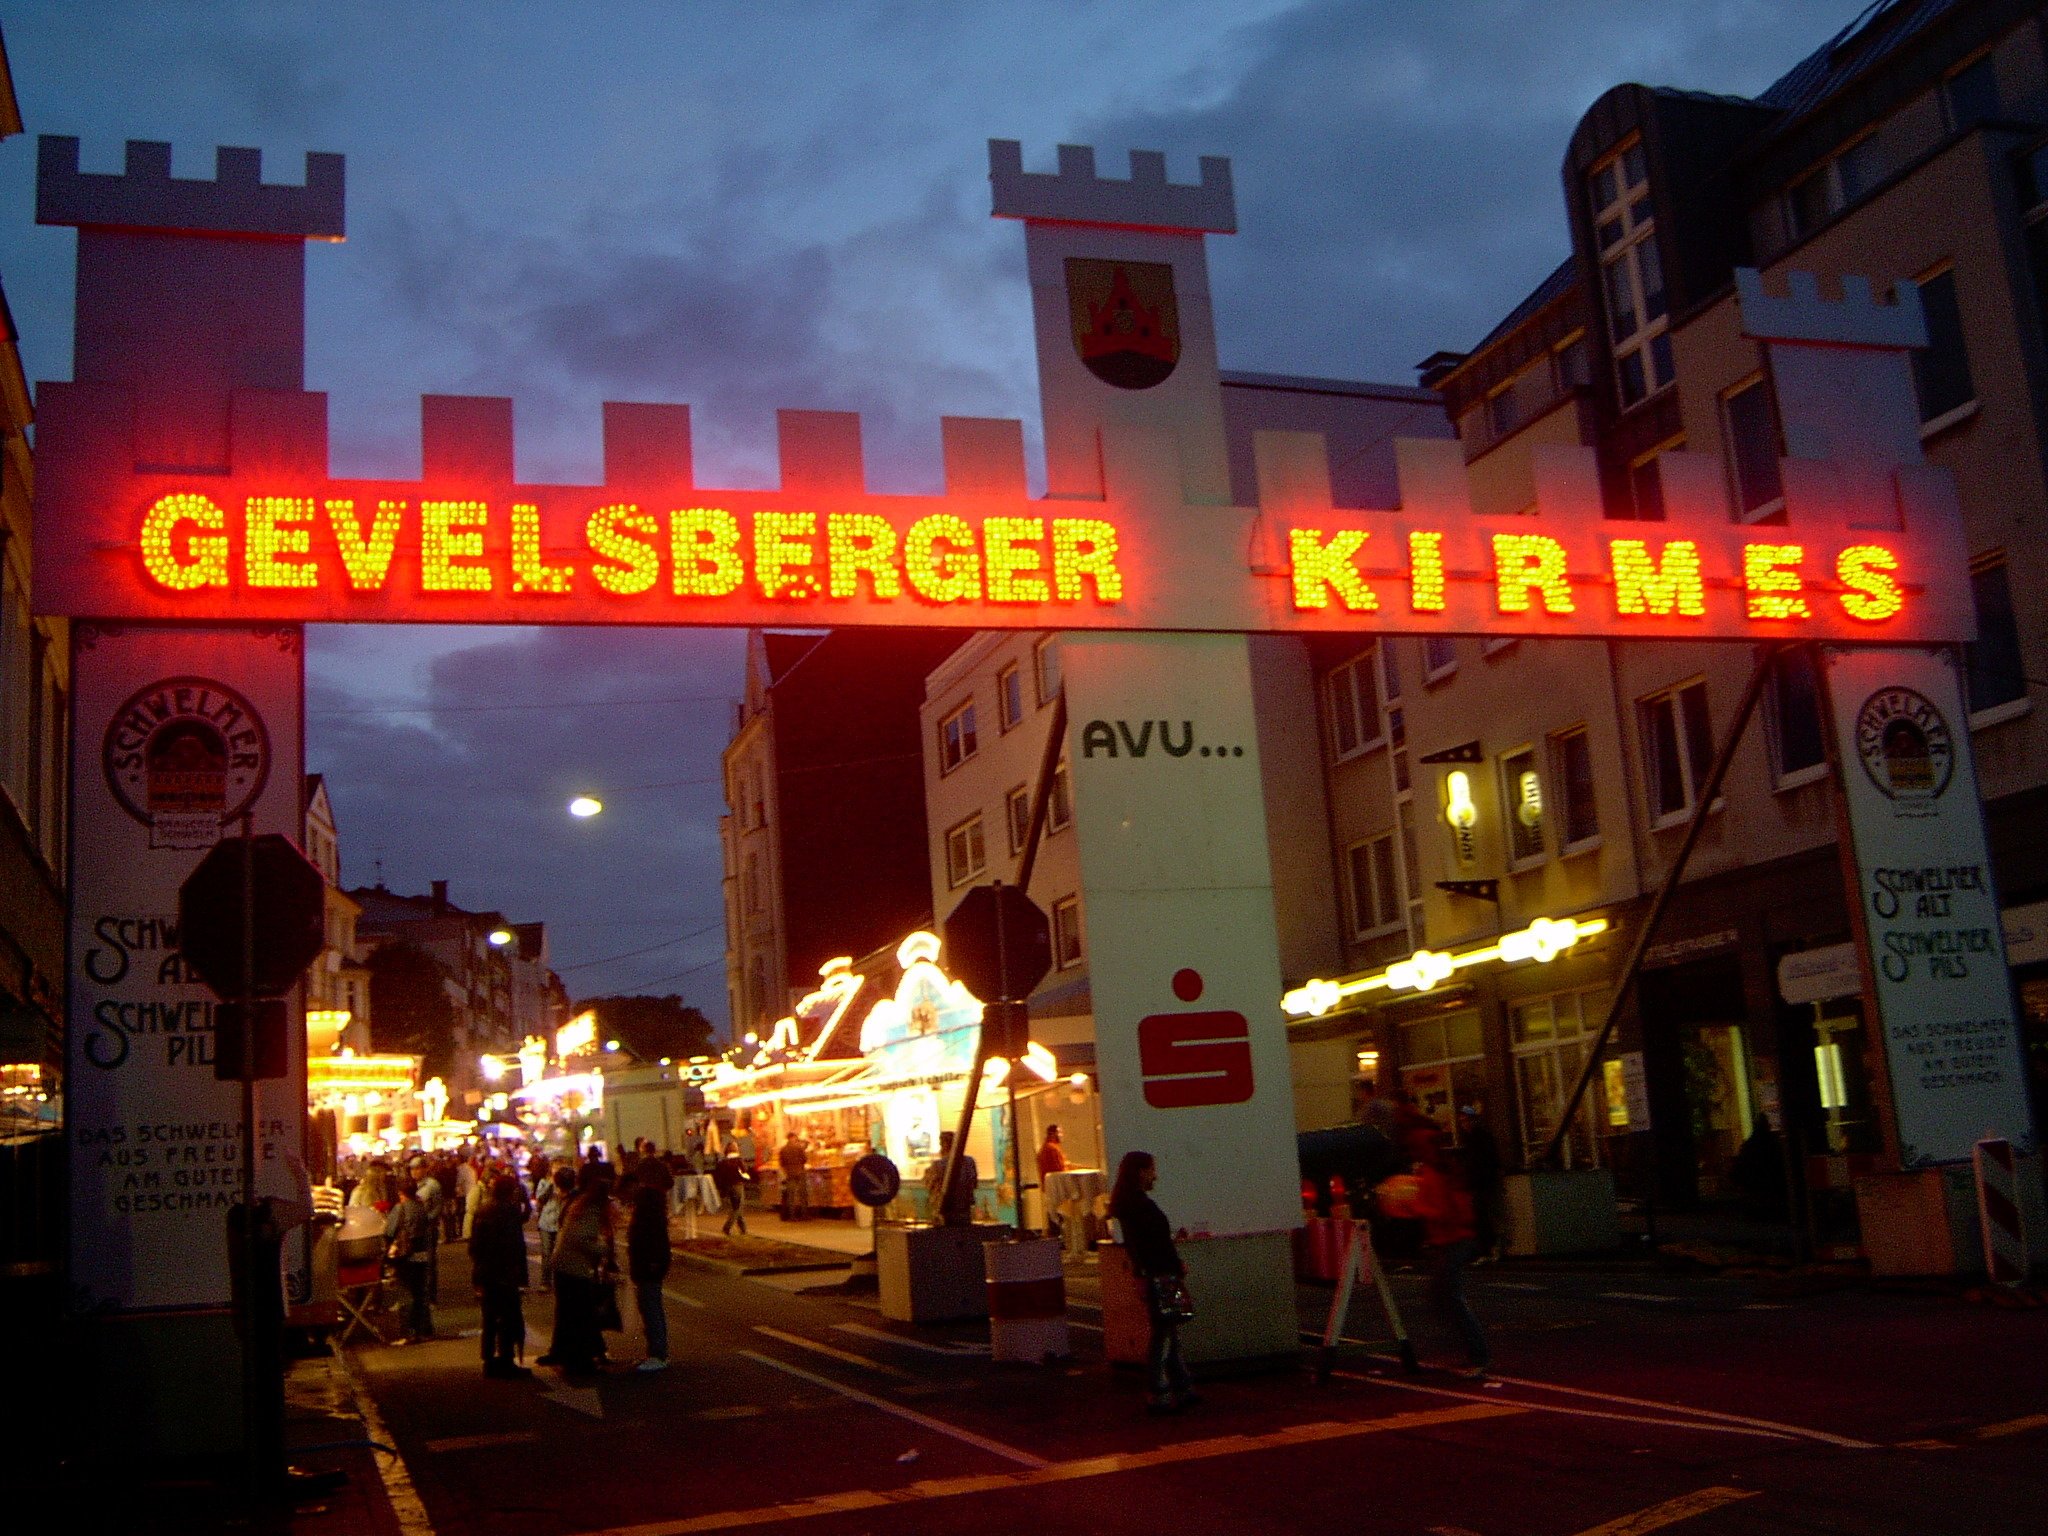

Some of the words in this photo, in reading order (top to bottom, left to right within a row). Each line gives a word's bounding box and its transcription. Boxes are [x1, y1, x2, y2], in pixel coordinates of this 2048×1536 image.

[140, 493, 1122, 602] GEVELSBERGER
[1290, 528, 1901, 620] KIRMES
[113, 687, 259, 769] SCHWELMER
[83, 1000, 216, 1070] SCHWEL
[168, 1036, 215, 1066] PIL
[79, 1126, 126, 1145] DAS
[98, 1149, 149, 1167] AUS
[165, 1142, 275, 1163] FREUE
[124, 1172, 160, 1189] AM
[115, 1190, 244, 1213] GESCHMAC
